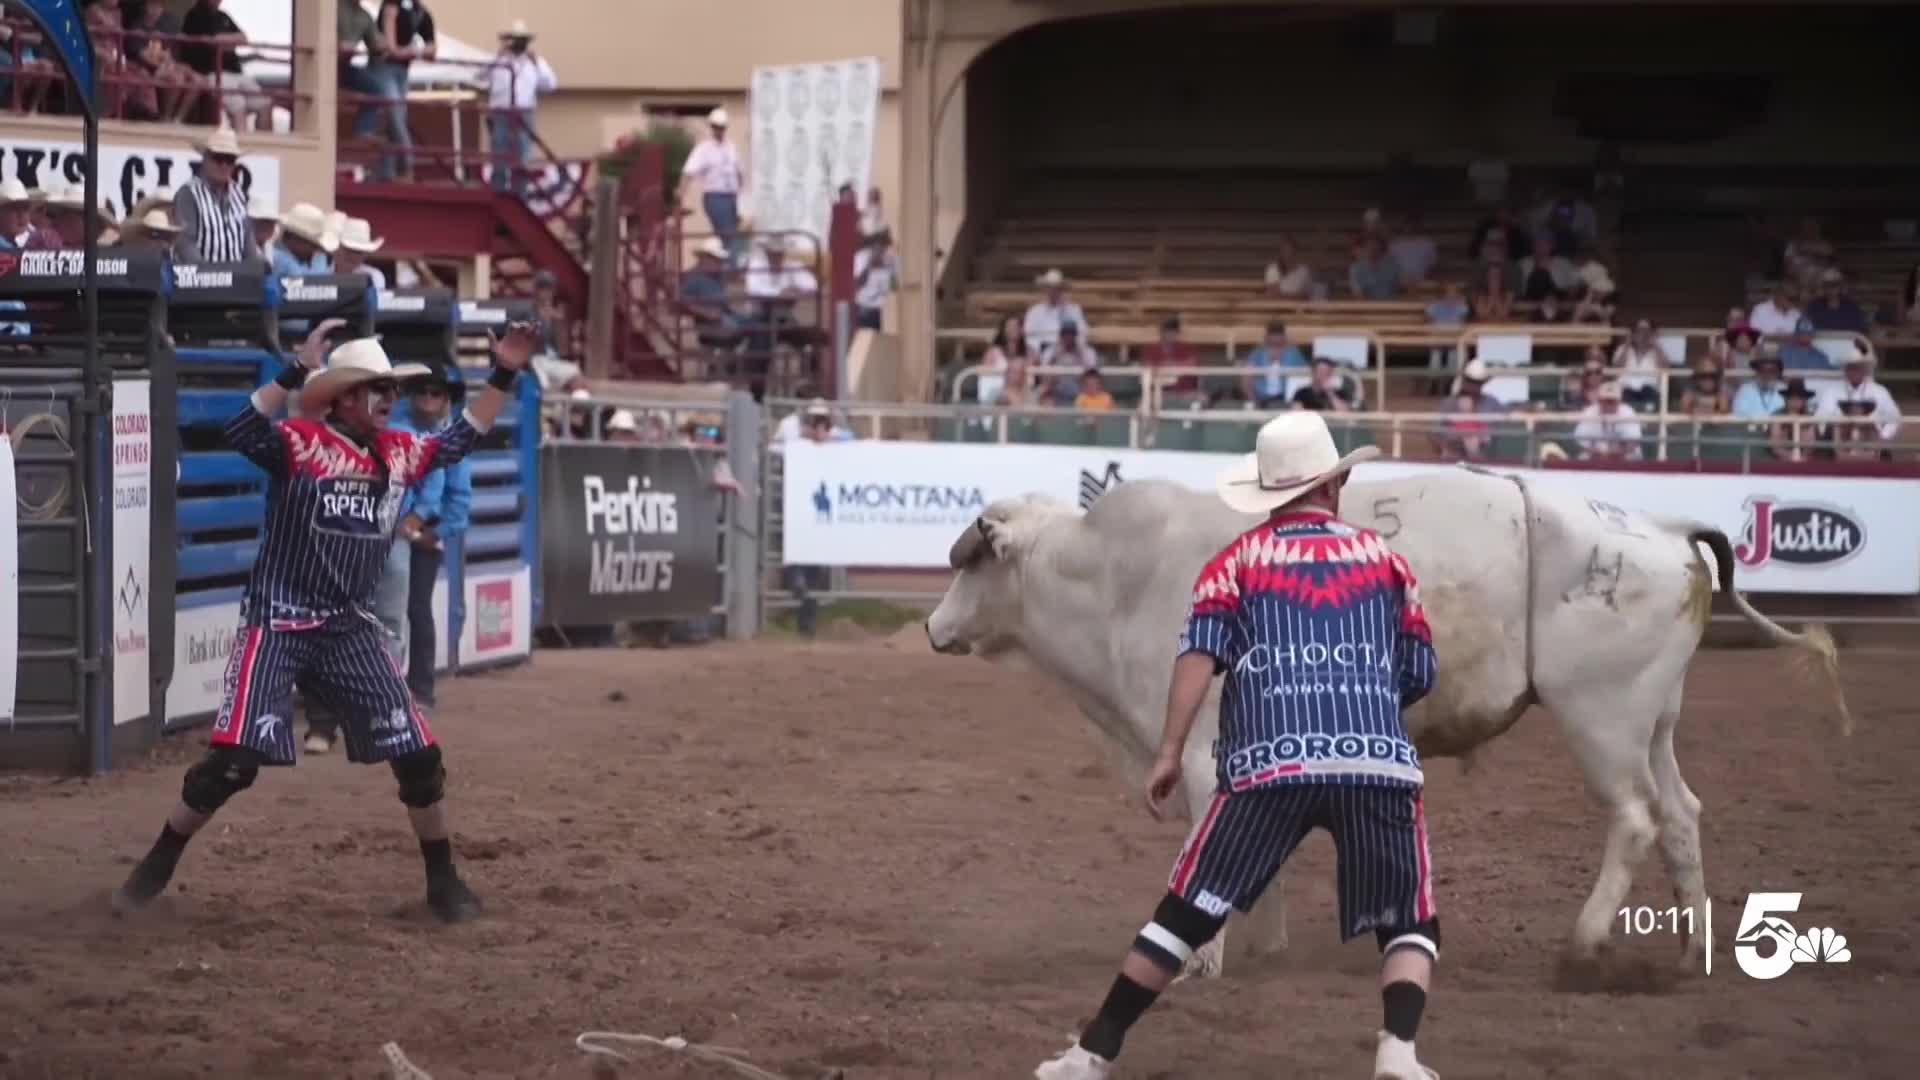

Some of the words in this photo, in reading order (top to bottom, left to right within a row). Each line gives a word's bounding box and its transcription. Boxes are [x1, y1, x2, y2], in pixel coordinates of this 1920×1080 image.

[115, 414, 148, 436] COLORADO
[115, 442, 148, 466] SPRINGS
[115, 485, 147, 509] COLORADO
[334, 480, 370, 494] NFR
[838, 483, 985, 509] MONTANA
[323, 493, 375, 523] OPEN
[583, 475, 678, 534] Perkins
[1734, 500, 1853, 567] Justin
[589, 536, 675, 594] Motors
